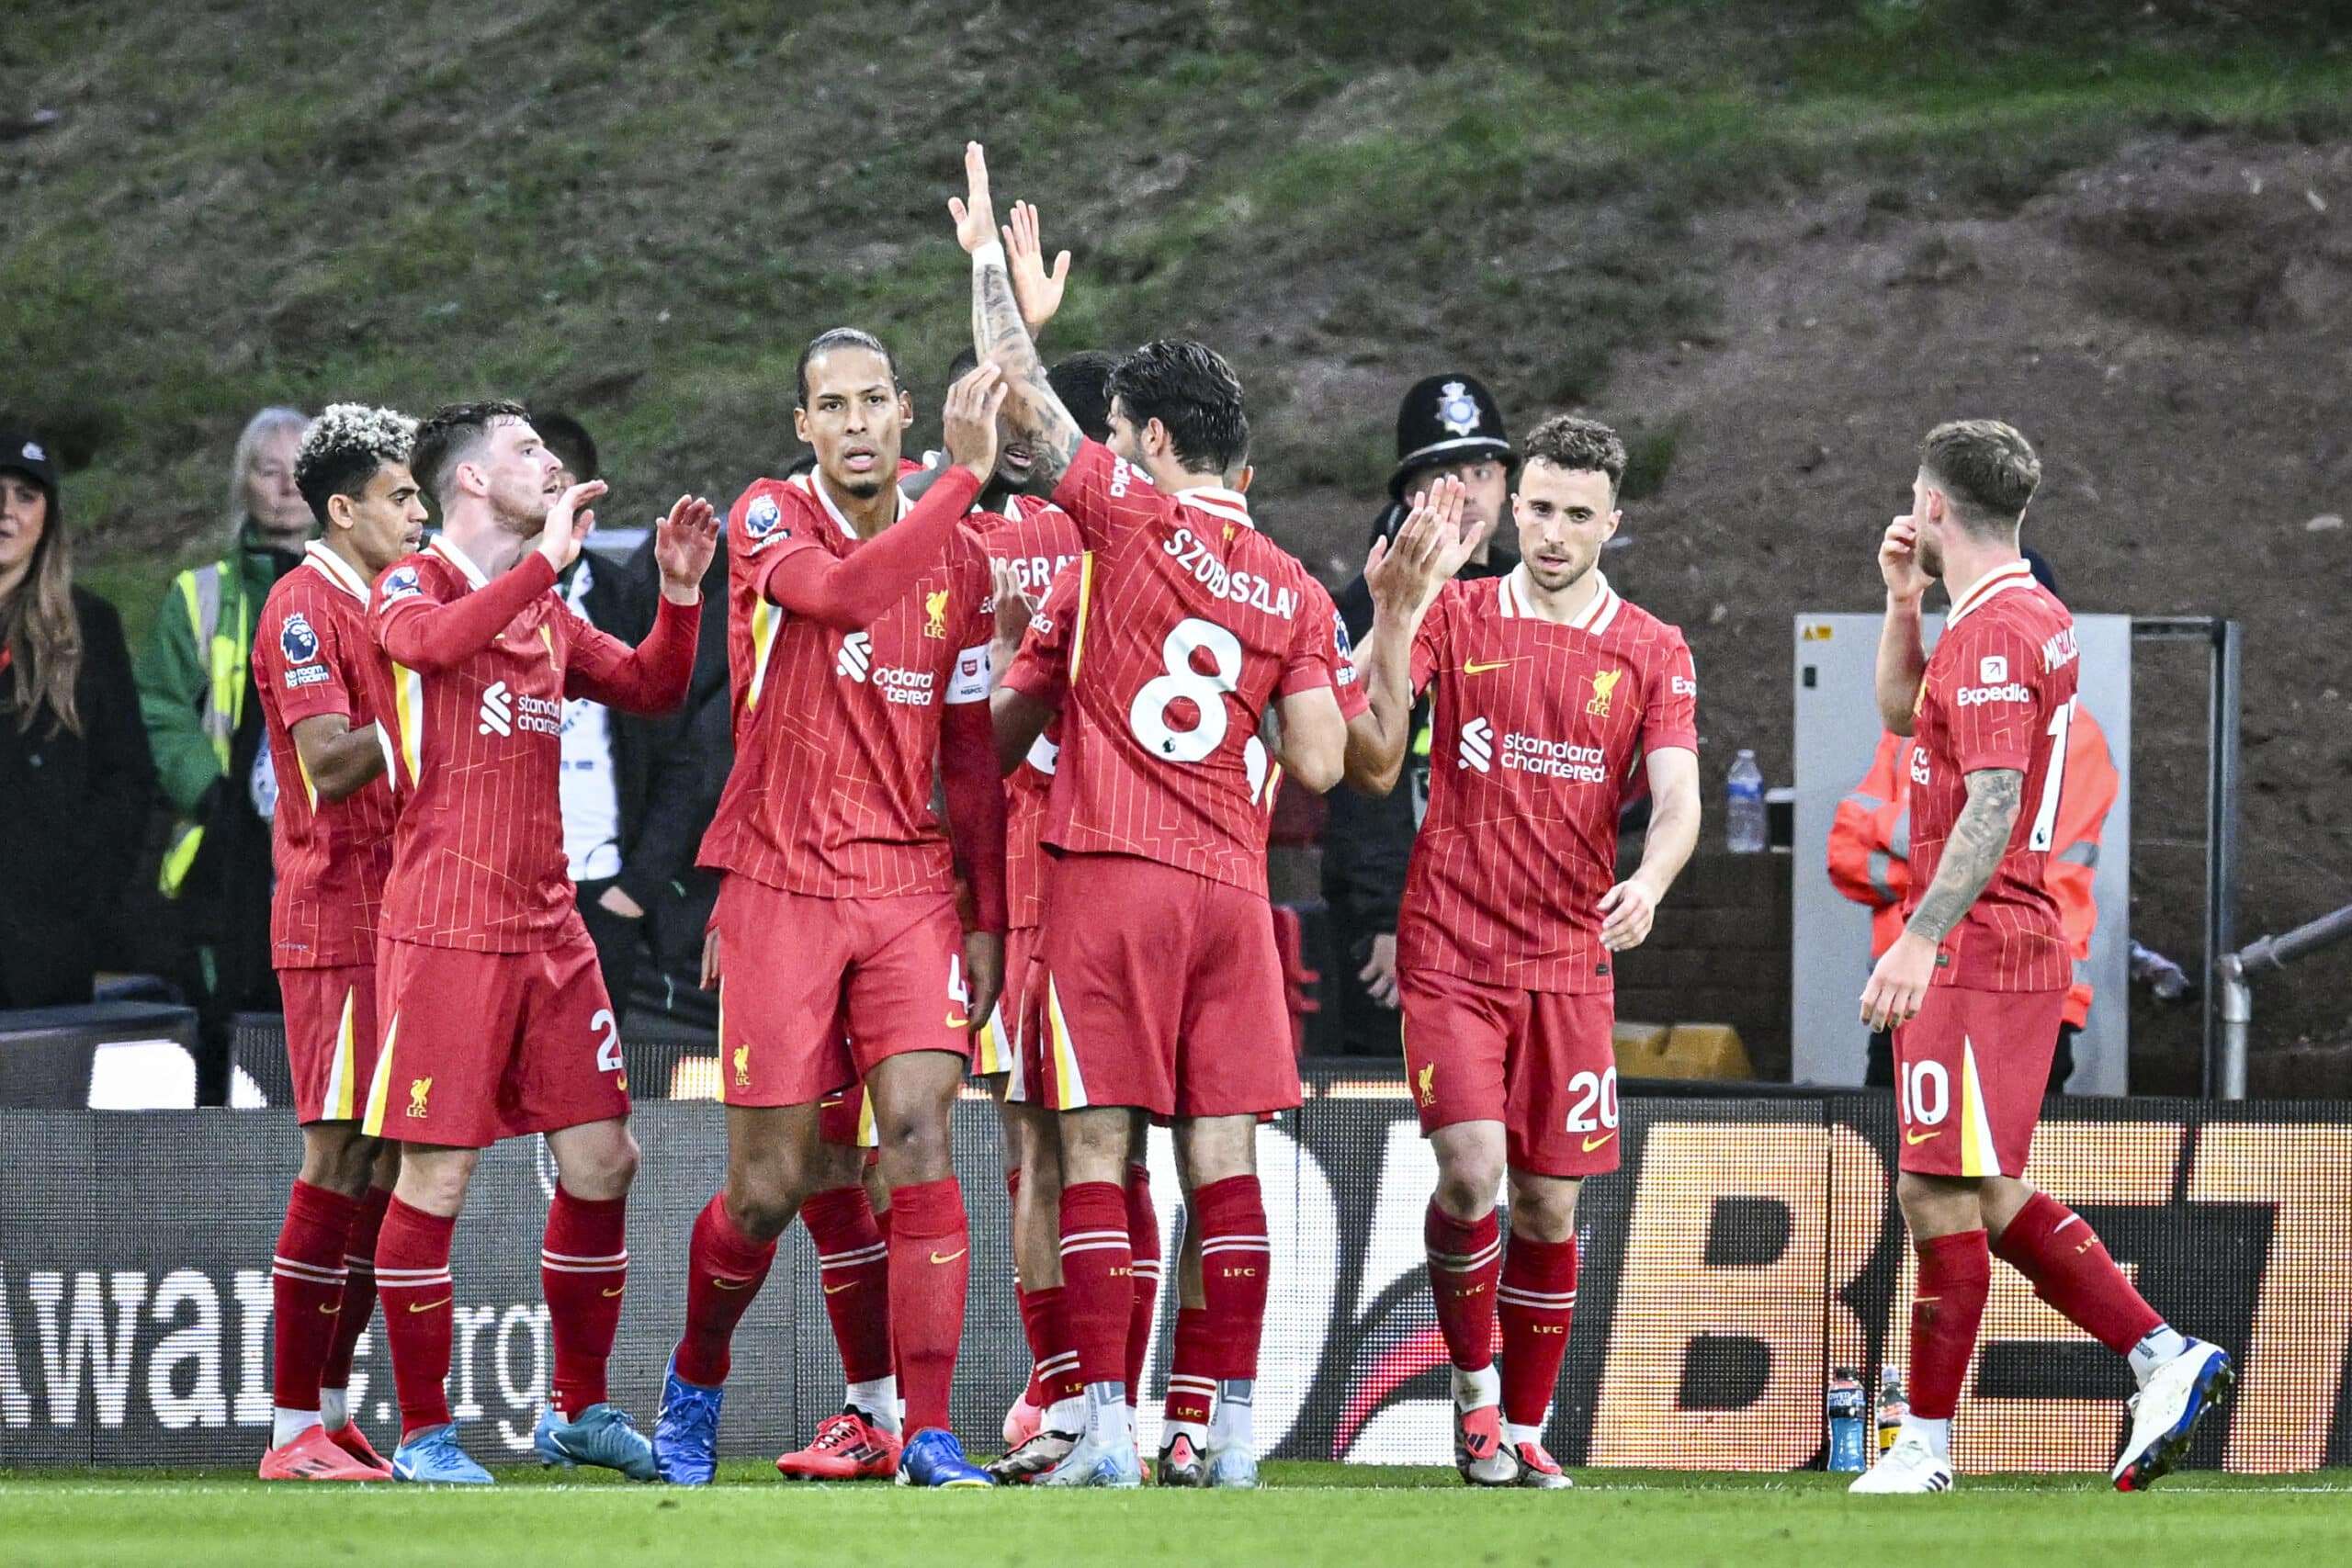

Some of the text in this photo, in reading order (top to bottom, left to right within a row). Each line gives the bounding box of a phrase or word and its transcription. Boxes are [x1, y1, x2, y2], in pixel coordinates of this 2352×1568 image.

[923, 624, 947, 640] LFC
[1129, 616, 1244, 762] 8
[1956, 682, 2030, 707] Expedia
[1585, 700, 1611, 718] LFC
[1502, 731, 1605, 764] standard
[1500, 751, 1606, 784] chartered
[2028, 693, 2078, 852] 1
[947, 953, 969, 1015] 4
[1566, 1065, 1619, 1133] 20
[1901, 1059, 1950, 1125] 10
[406, 1105, 428, 1119] LFC
[2075, 1234, 2099, 1255] LFC
[1109, 1267, 1133, 1277] LFC
[1223, 1268, 1257, 1278] LFC
[1455, 1282, 1486, 1297] LFC
[1532, 1324, 1565, 1335] LFC
[1065, 1382, 1083, 1393] LF
[1177, 1406, 1204, 1418] LFC
